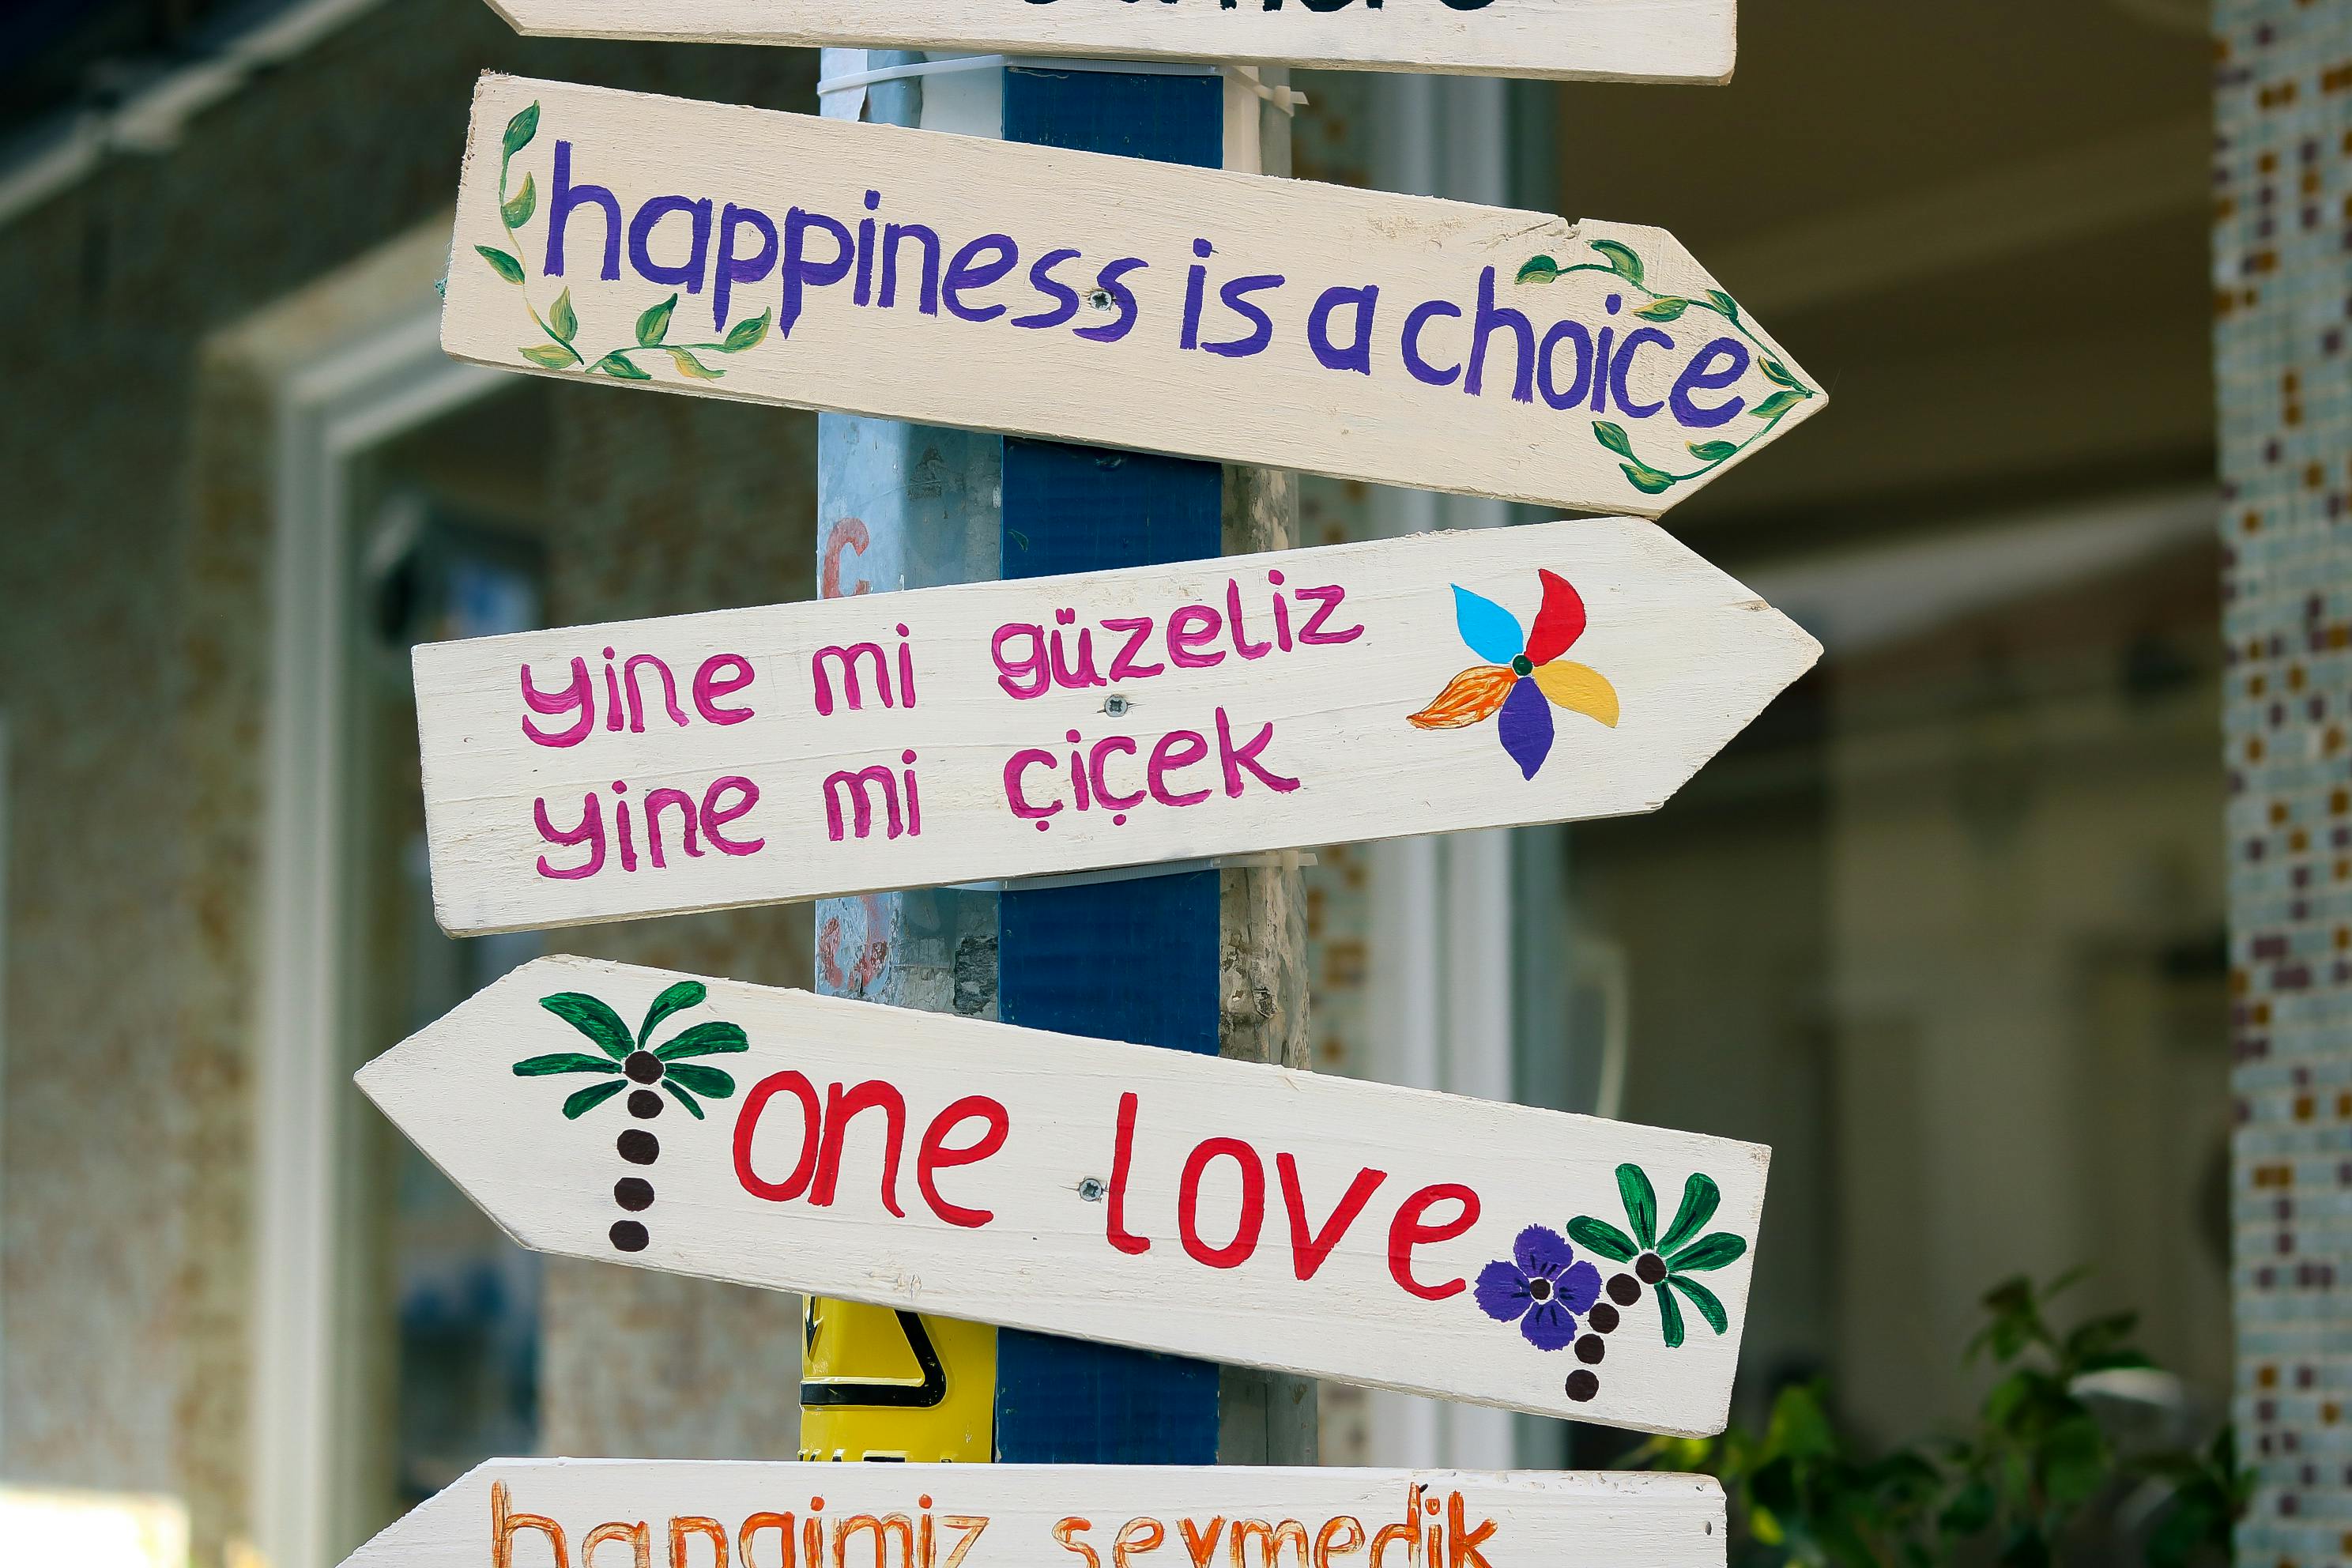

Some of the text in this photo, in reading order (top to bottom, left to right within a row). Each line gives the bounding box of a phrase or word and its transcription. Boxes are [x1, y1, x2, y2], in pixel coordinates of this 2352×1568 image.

[543, 140, 1750, 428] happiness is a choice
[520, 569, 1365, 748] yine mi güzeliz
[533, 707, 1301, 880] yine mi çiçek
[733, 1070, 1481, 1302] one love
